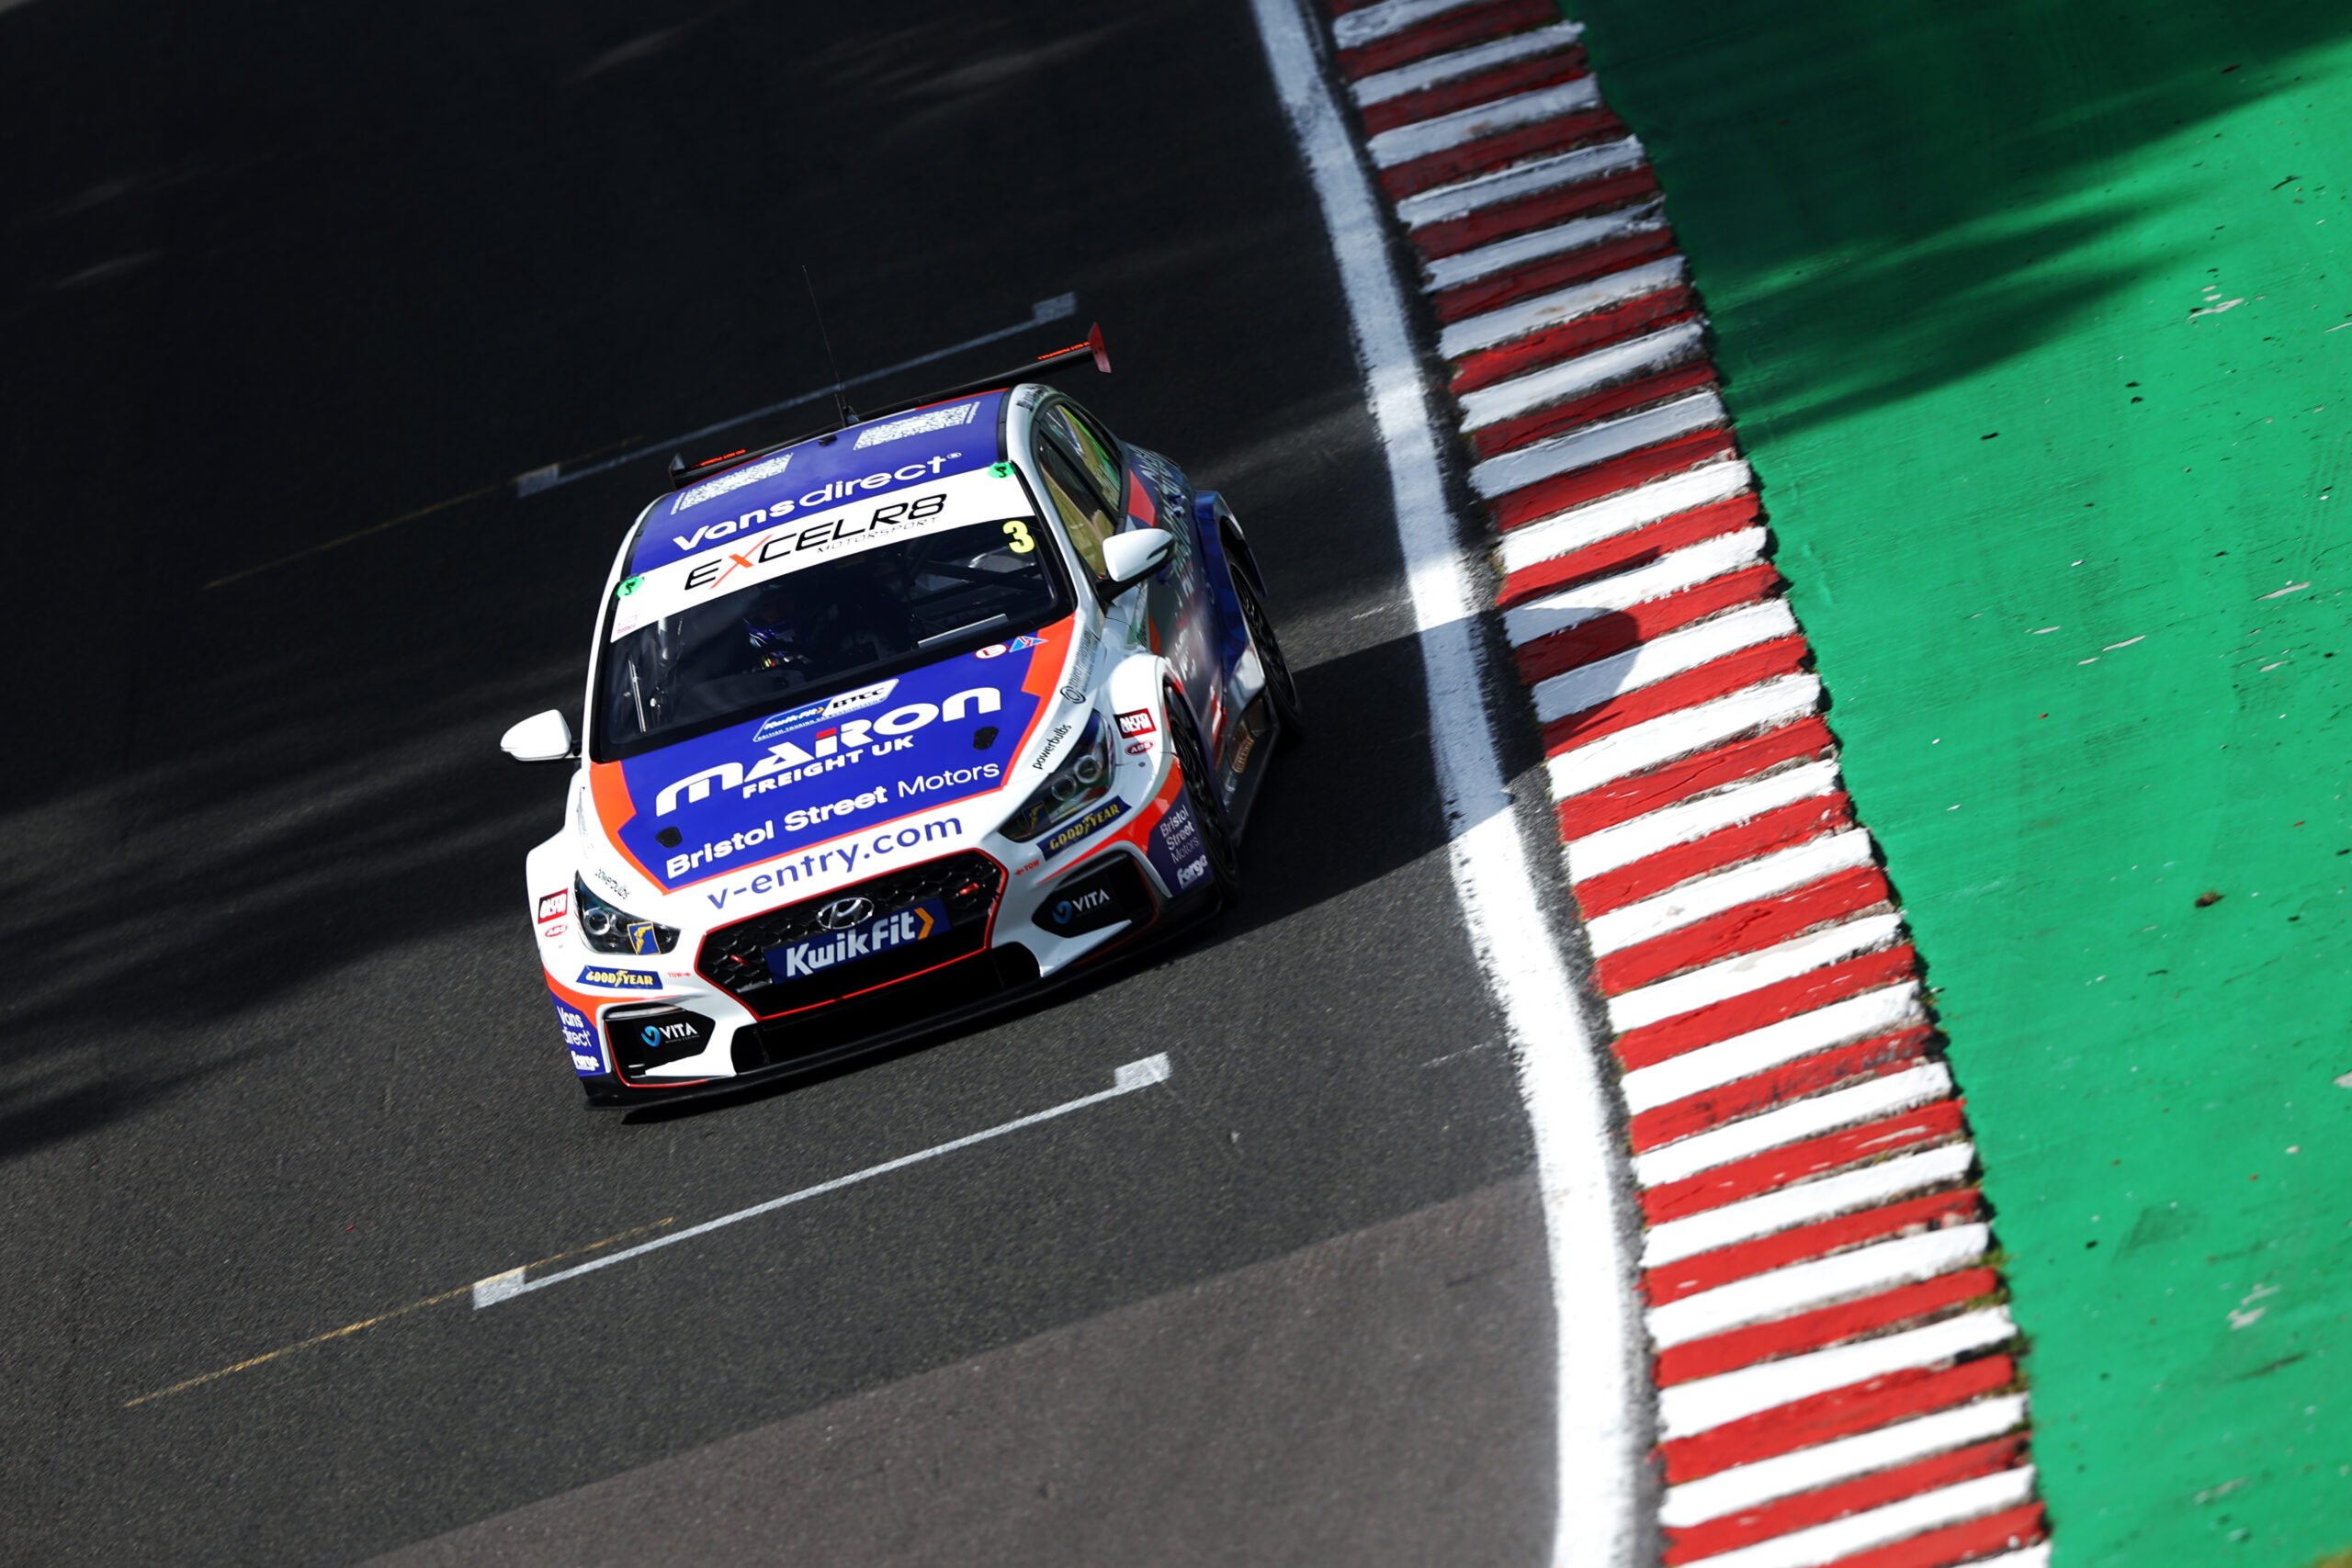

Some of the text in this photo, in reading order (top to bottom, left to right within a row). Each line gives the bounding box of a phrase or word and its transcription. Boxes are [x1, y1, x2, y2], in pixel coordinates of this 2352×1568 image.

[684, 493, 947, 591] EXCELR8
[1002, 520, 1035, 554] 3
[832, 688, 885, 709] BTCC
[1032, 724, 1072, 770] powerbulbs
[742, 735, 915, 799] FREIGHT UK
[666, 763, 1000, 879] Bristol Street Motors
[1049, 804, 1120, 851] GOODYEAR
[1159, 804, 1190, 838] Bristol
[1166, 820, 1195, 851] Street
[707, 817, 963, 910] v-entry.com
[1170, 836, 1200, 863] Motors
[1072, 888, 1110, 911] VITA
[585, 971, 653, 987] GOODYEAR
[557, 1006, 584, 1029] Vans
[659, 1022, 698, 1039] VITA
